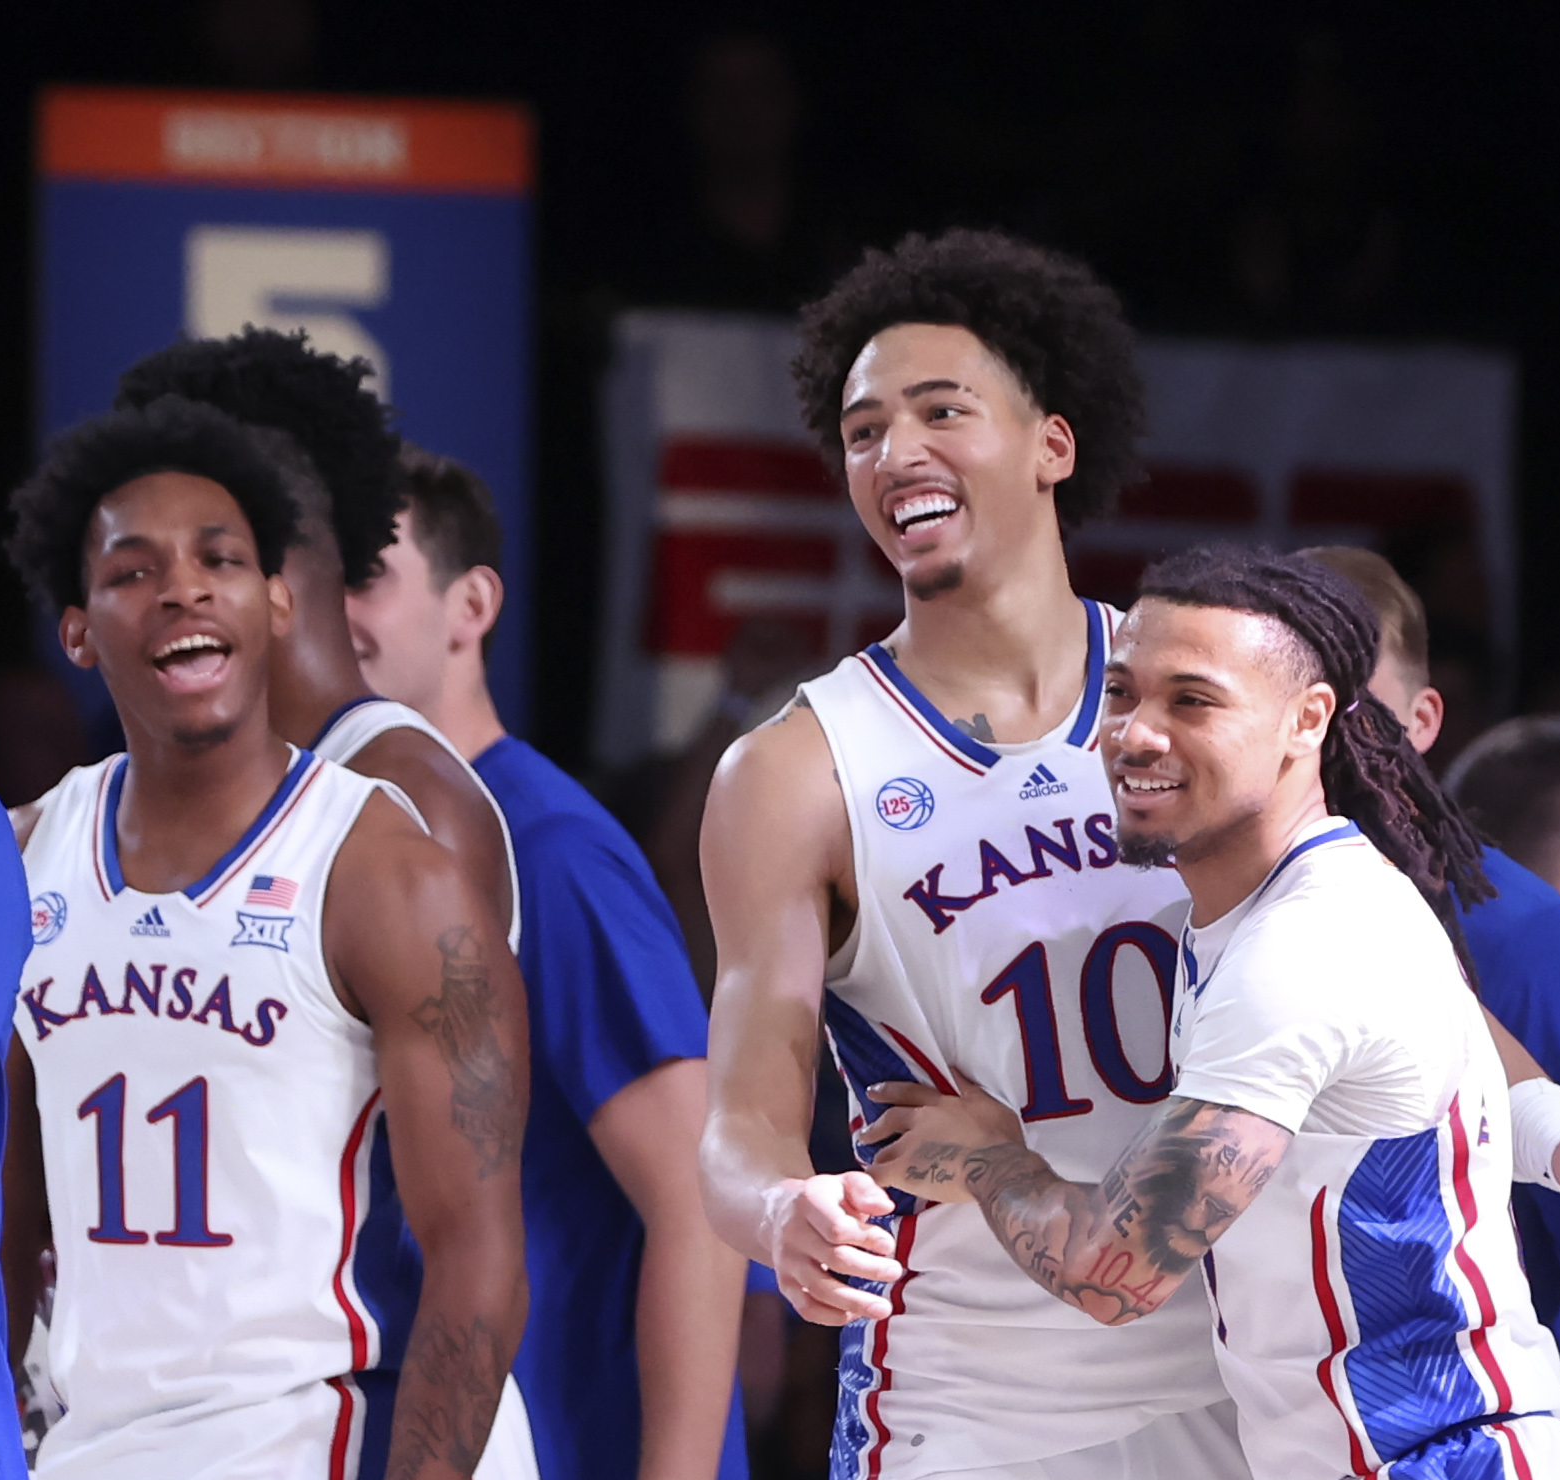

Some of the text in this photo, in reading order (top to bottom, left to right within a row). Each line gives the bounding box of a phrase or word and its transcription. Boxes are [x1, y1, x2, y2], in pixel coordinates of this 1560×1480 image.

[882, 797, 910, 817] 125
[1019, 781, 1069, 800] adidas
[903, 813, 1129, 935] KANS
[21, 961, 288, 1047] KANSAS
[980, 920, 1179, 1124] 10
[77, 1072, 234, 1247] 11
